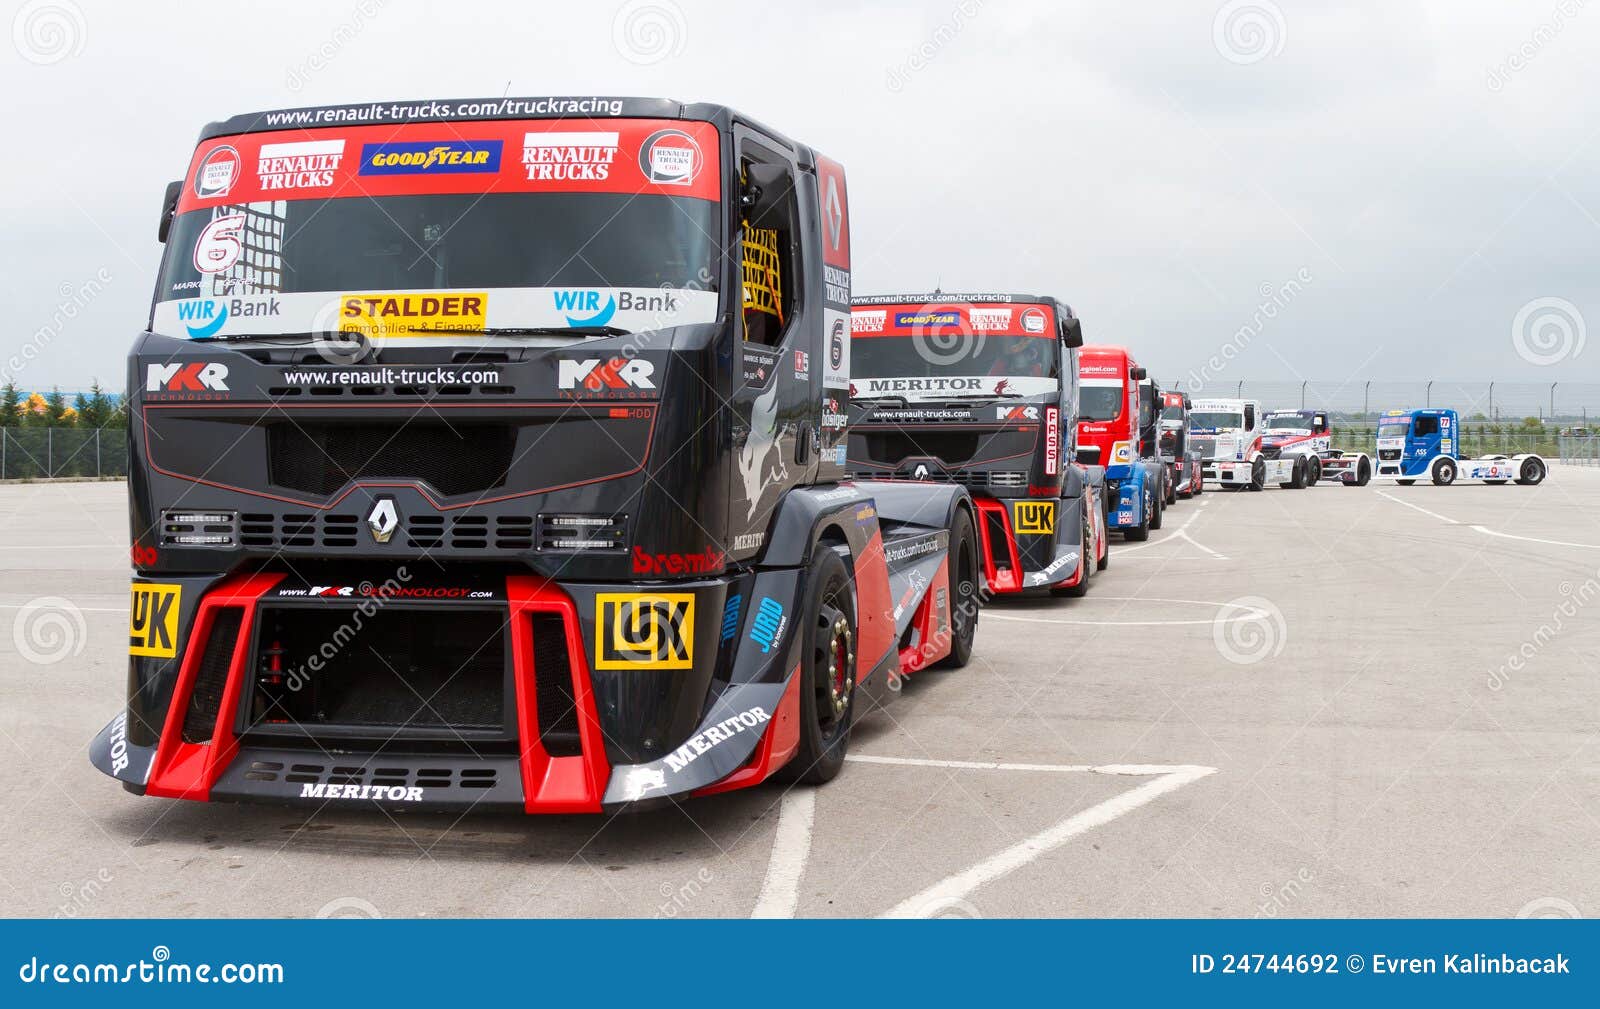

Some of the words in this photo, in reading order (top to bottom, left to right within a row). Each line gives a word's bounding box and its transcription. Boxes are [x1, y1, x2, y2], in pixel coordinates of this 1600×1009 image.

[266, 97, 623, 125] www.renault-trucks.com/truckracing
[257, 154, 343, 175] RENAULT
[521, 147, 618, 164] RENAULT
[259, 171, 334, 190] TRUCKS
[525, 163, 609, 180] TRUCKS
[192, 214, 248, 273] 6
[177, 300, 216, 321] WIR
[230, 298, 280, 317] Bank
[344, 297, 482, 318] STALDER
[553, 290, 601, 312] WIR
[618, 291, 677, 312] Bank
[851, 317, 886, 325] ENAULT
[969, 314, 1011, 324] RENAULT
[972, 322, 1009, 331] TRUCKS
[284, 367, 500, 385] www.renault-trucks.com
[869, 378, 983, 391] MERITOR
[873, 410, 971, 418] www.renault-trucks.com
[750, 597, 782, 653] JURID
[664, 706, 772, 773] MERITOR
[300, 784, 423, 801] MERITOR
